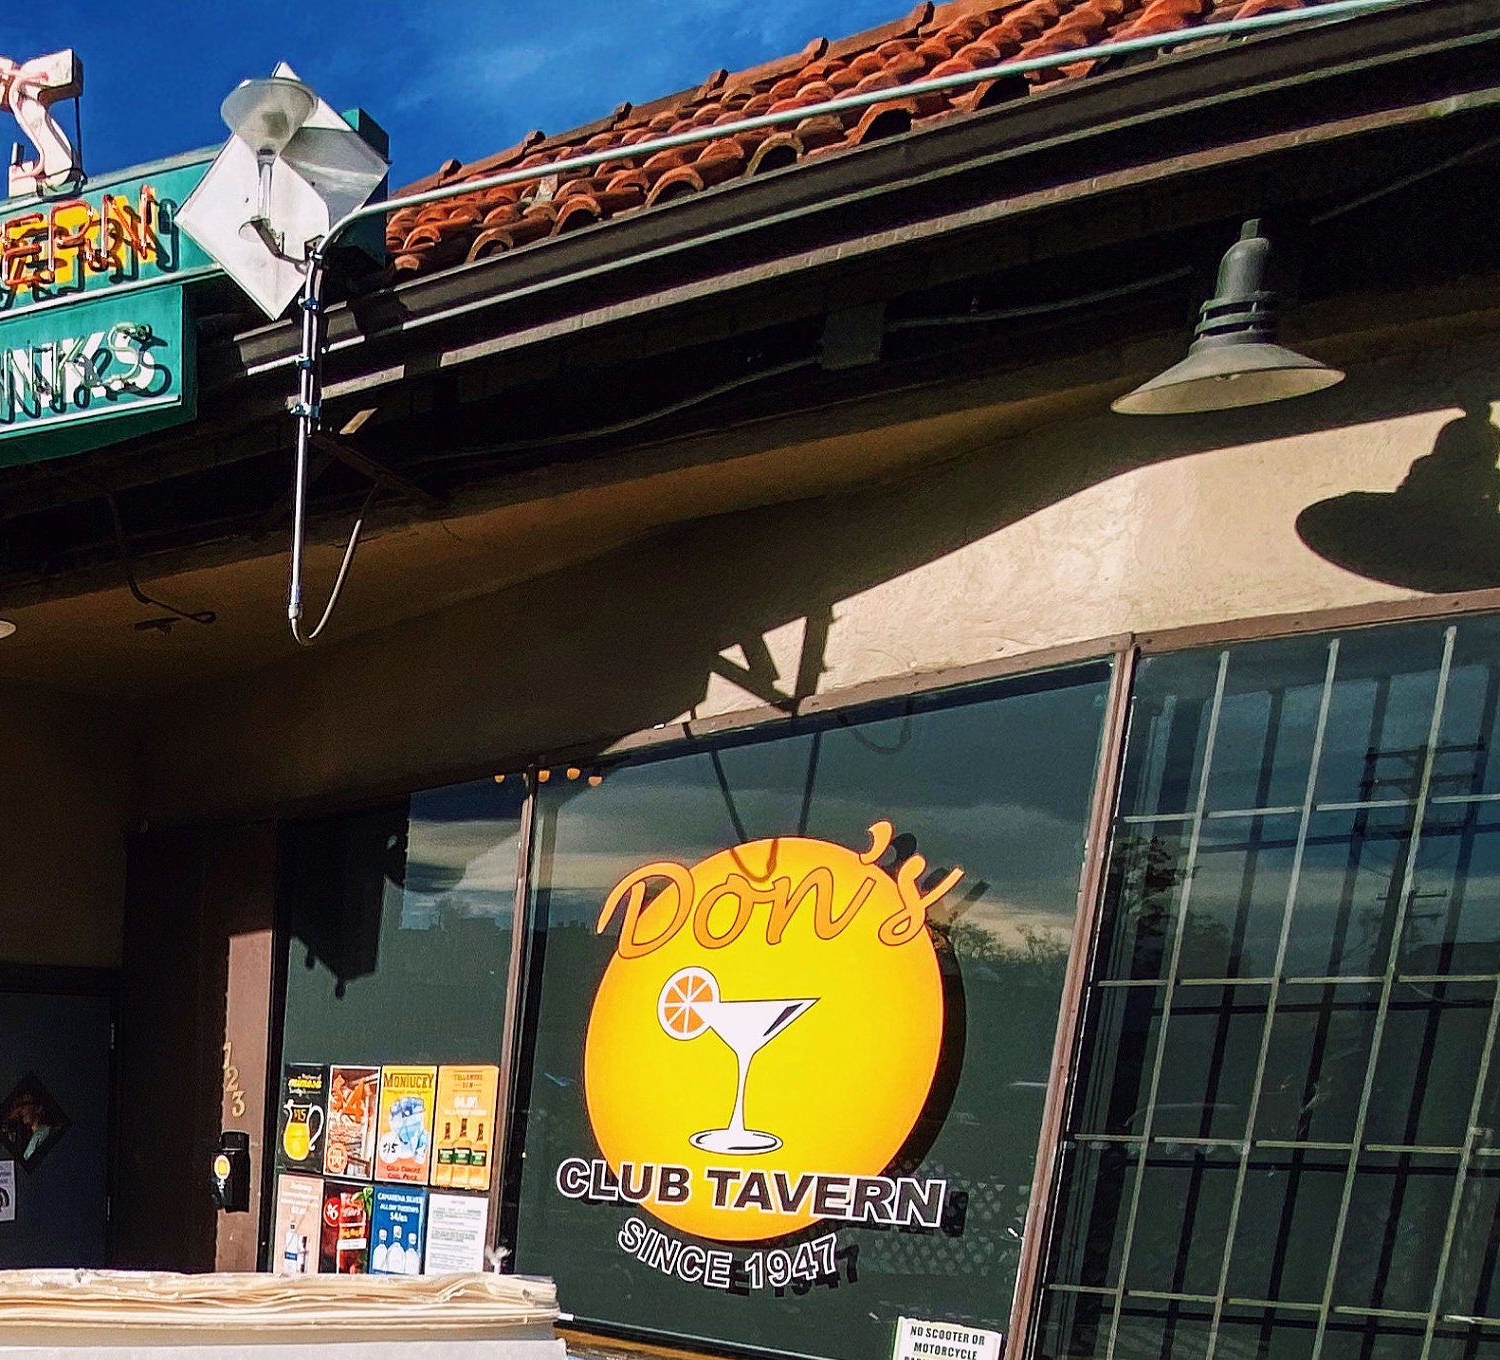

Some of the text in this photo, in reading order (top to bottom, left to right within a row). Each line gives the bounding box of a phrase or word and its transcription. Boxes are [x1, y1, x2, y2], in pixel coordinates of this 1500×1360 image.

[597, 819, 964, 960] Don's
[384, 1073, 434, 1088] MONTUCKY
[556, 1157, 947, 1227] CLUB TAVERN
[618, 1217, 839, 1289] SINCE 1947
[910, 1325, 985, 1346] NO SCOOTER OR
[914, 1342, 977, 1360] MOTORCYCLE
